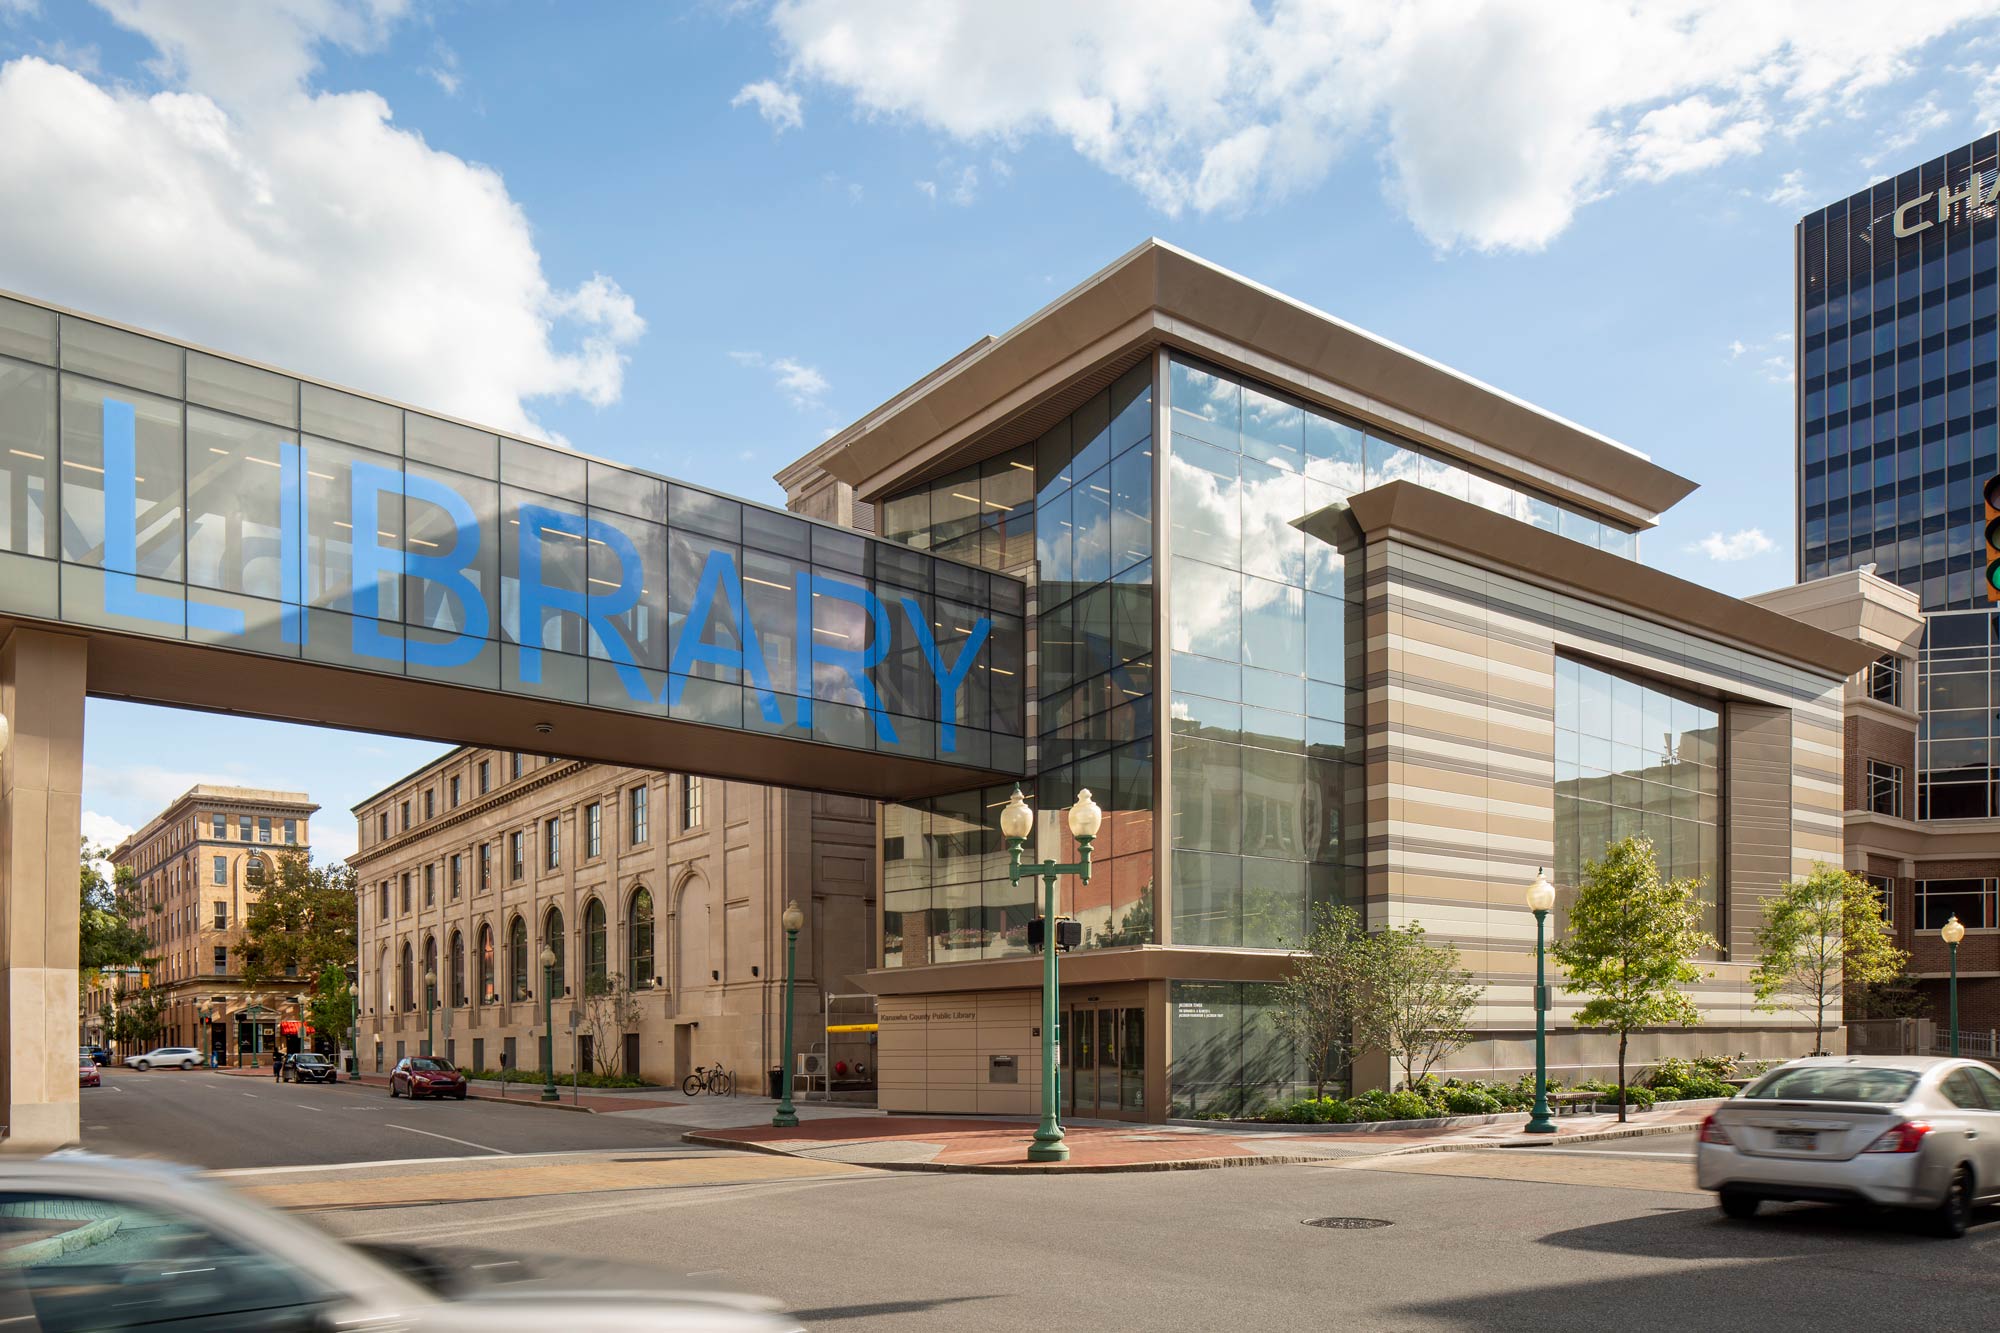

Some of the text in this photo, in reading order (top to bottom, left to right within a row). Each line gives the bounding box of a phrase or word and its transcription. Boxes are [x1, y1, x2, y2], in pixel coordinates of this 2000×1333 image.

[103, 397, 995, 753] LIBRARY
[880, 1011, 976, 1022] Kanawha County Public Library
